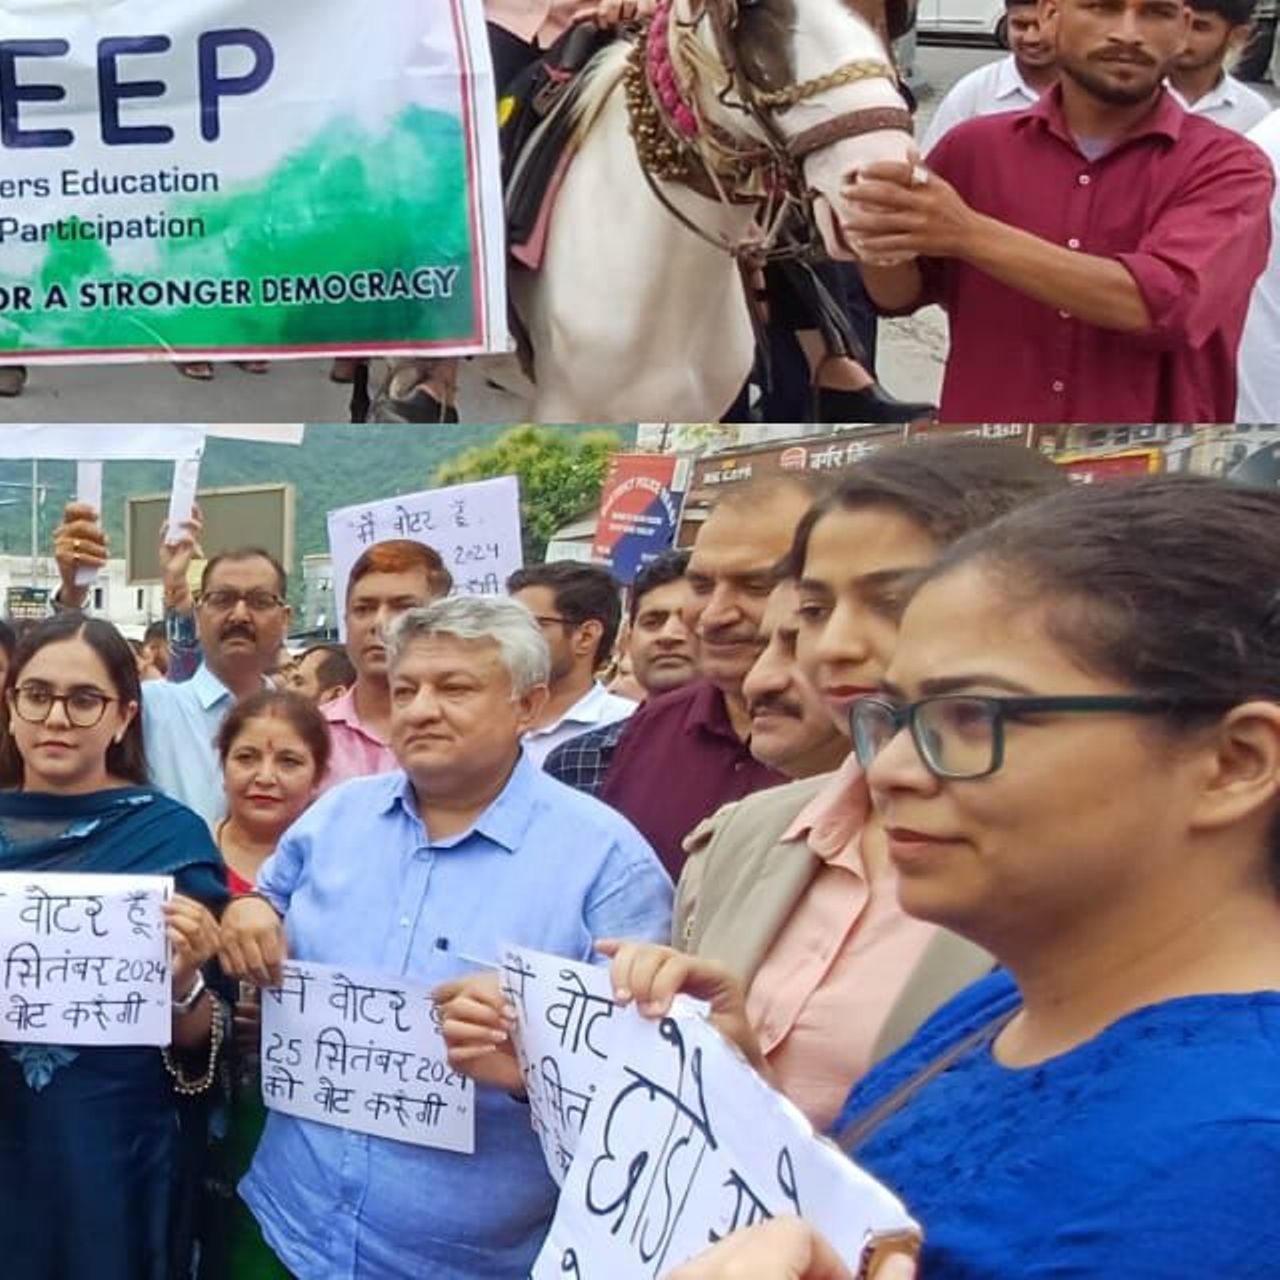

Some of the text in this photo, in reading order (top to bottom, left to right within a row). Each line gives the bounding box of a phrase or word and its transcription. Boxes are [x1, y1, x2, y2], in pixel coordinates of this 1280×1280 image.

[63, 166, 218, 196] Education
[44, 285, 68, 309] A
[80, 280, 251, 309] STRONGER
[262, 268, 458, 305] DEMOCRACY
[19, 884, 109, 936] वोटर
[4, 942, 113, 990] सितंबर
[116, 959, 167, 985] 2024
[329, 973, 411, 1032] वोटर
[264, 1065, 304, 1100] को
[266, 1026, 468, 1091] 25 सितंबर 2024
